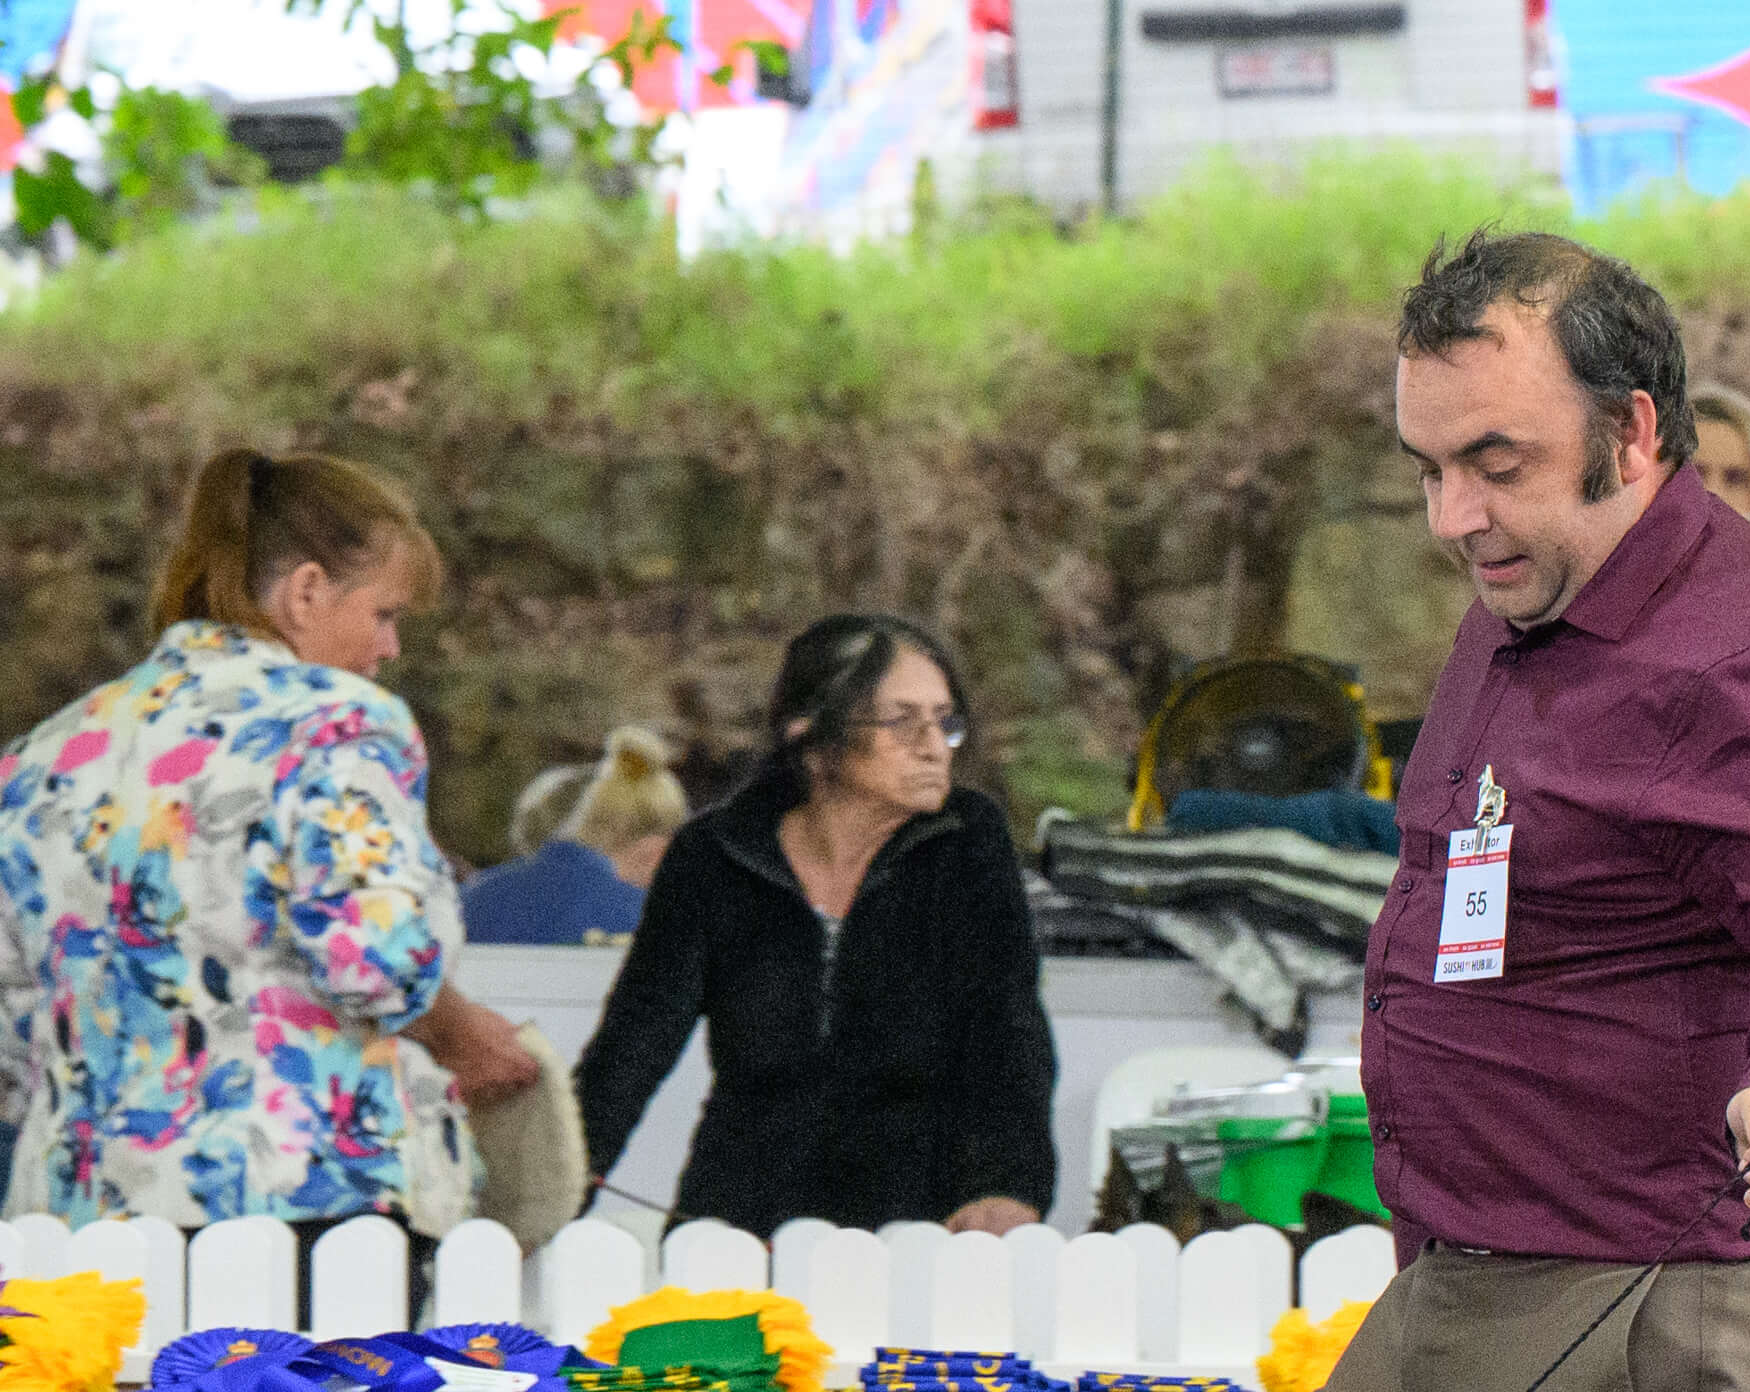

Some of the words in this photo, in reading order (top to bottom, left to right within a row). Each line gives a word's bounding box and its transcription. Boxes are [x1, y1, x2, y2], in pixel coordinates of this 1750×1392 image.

[1465, 891, 1488, 917] 55
[1443, 959, 1465, 974] SUSHI
[1471, 958, 1485, 972] HUB
